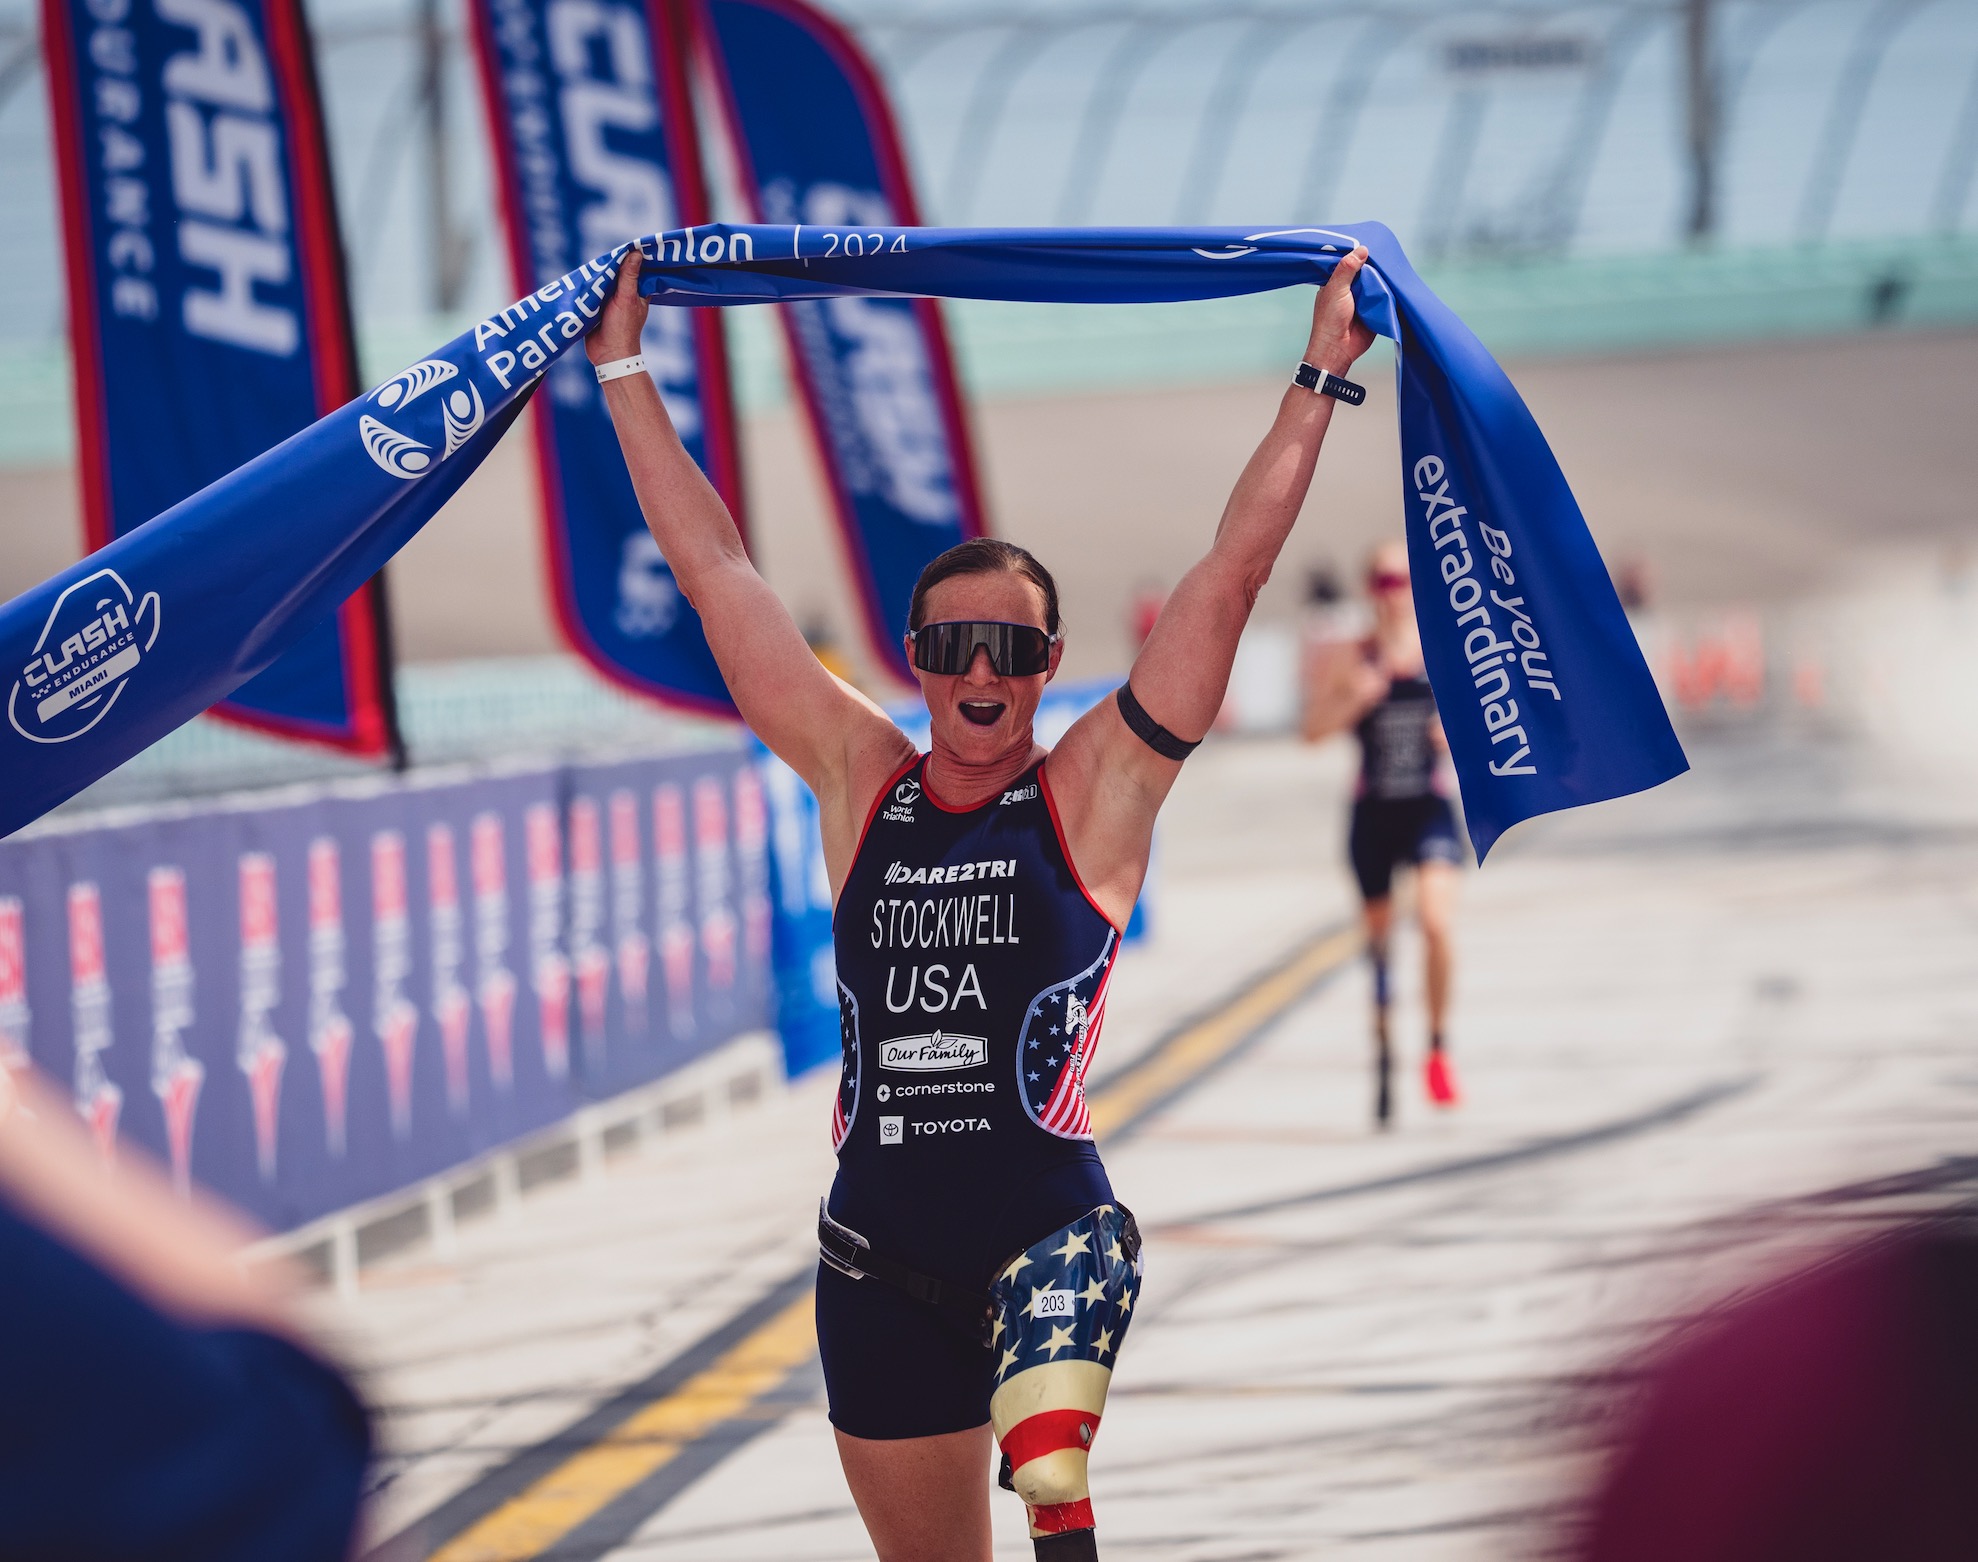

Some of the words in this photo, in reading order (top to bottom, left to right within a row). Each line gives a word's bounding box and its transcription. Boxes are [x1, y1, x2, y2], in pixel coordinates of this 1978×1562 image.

[822, 233, 909, 258] 2024
[1478, 521, 1515, 585] Be
[1413, 454, 1538, 777] extraordinary
[23, 603, 130, 687] CLASH
[1490, 590, 1561, 701] your
[54, 632, 135, 688] ENDURANCE
[68, 669, 109, 699] MIAMI
[882, 811, 915, 823] Triathlon
[890, 804, 913, 815] World
[884, 859, 1017, 885] DARE2TRI
[870, 893, 1020, 949] STOCKWELL
[885, 963, 988, 1014] USA
[887, 1047, 917, 1062] Our
[919, 1043, 980, 1066] Family
[895, 1081, 996, 1097] cornerstone
[911, 1118, 992, 1135] TOYOTA
[1041, 1294, 1066, 1313] 203
